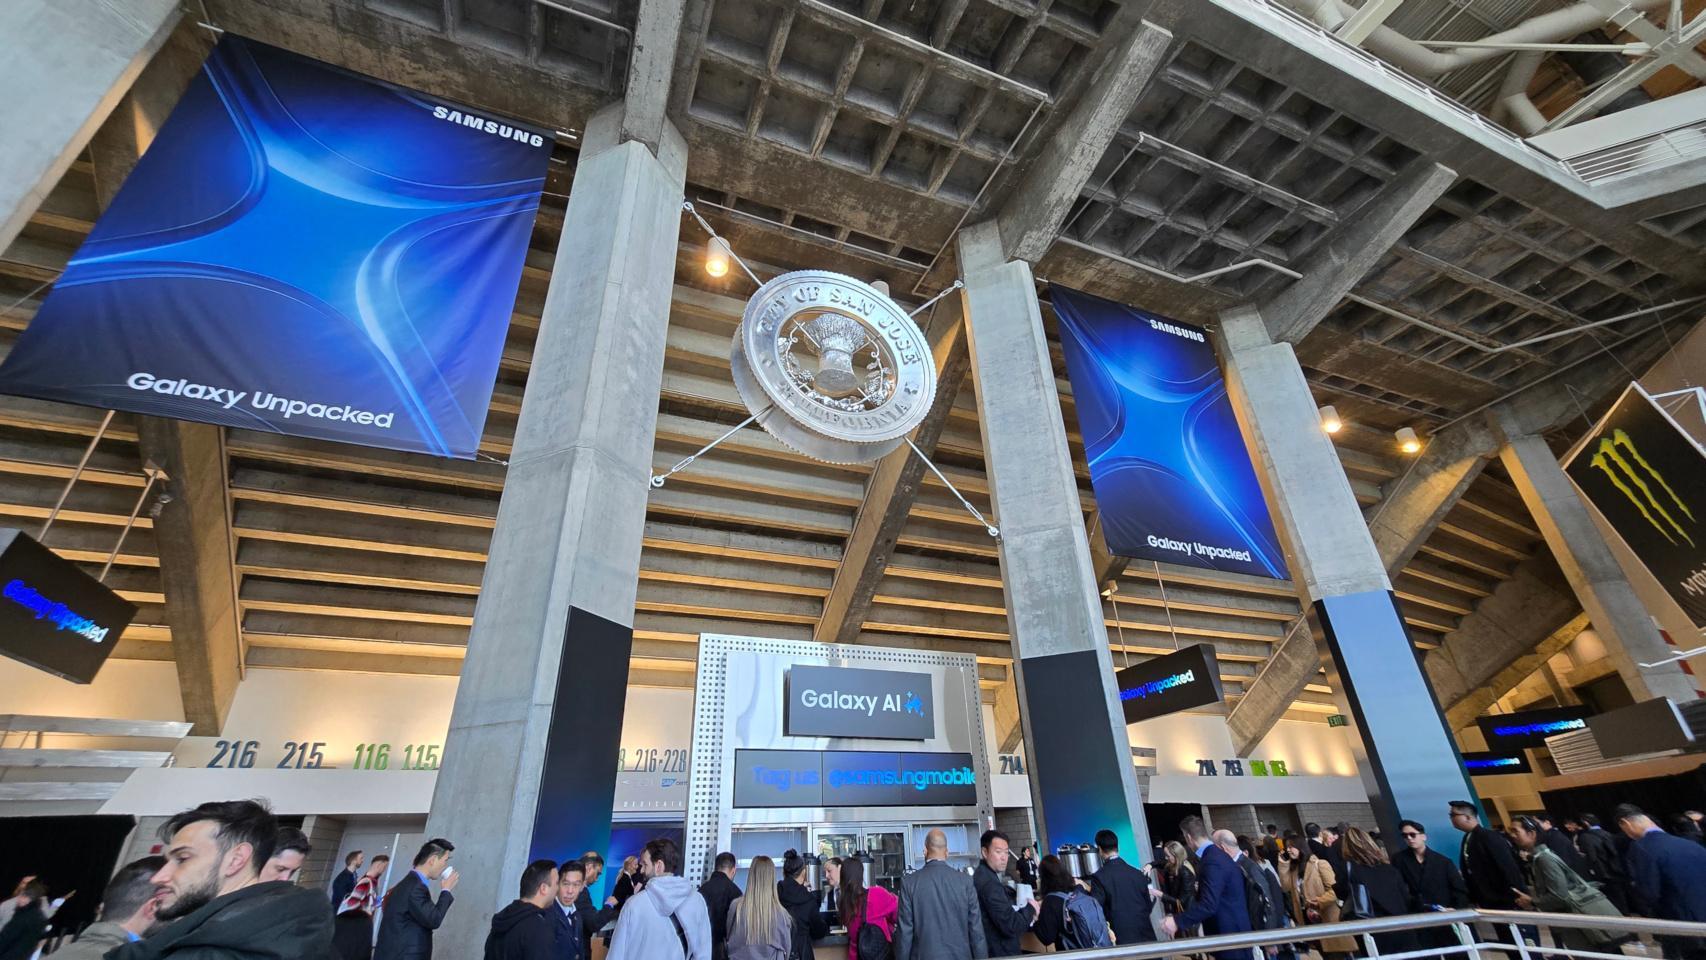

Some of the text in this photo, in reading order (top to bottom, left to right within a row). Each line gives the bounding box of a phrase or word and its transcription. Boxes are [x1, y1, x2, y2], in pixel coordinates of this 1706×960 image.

[433, 106, 543, 147] SAMSUNG
[757, 286, 921, 366] CITY OF SAN JOSE
[1149, 319, 1204, 342] SAMSUNG
[127, 372, 394, 428] Galaxy Unpacked
[1147, 535, 1252, 562] Galaxy Unpacked
[1145, 669, 1195, 694] Unpacked
[801, 689, 901, 716] Galaxy AI
[207, 740, 440, 770] 216 215 116 115
[999, 755, 1024, 775] 214
